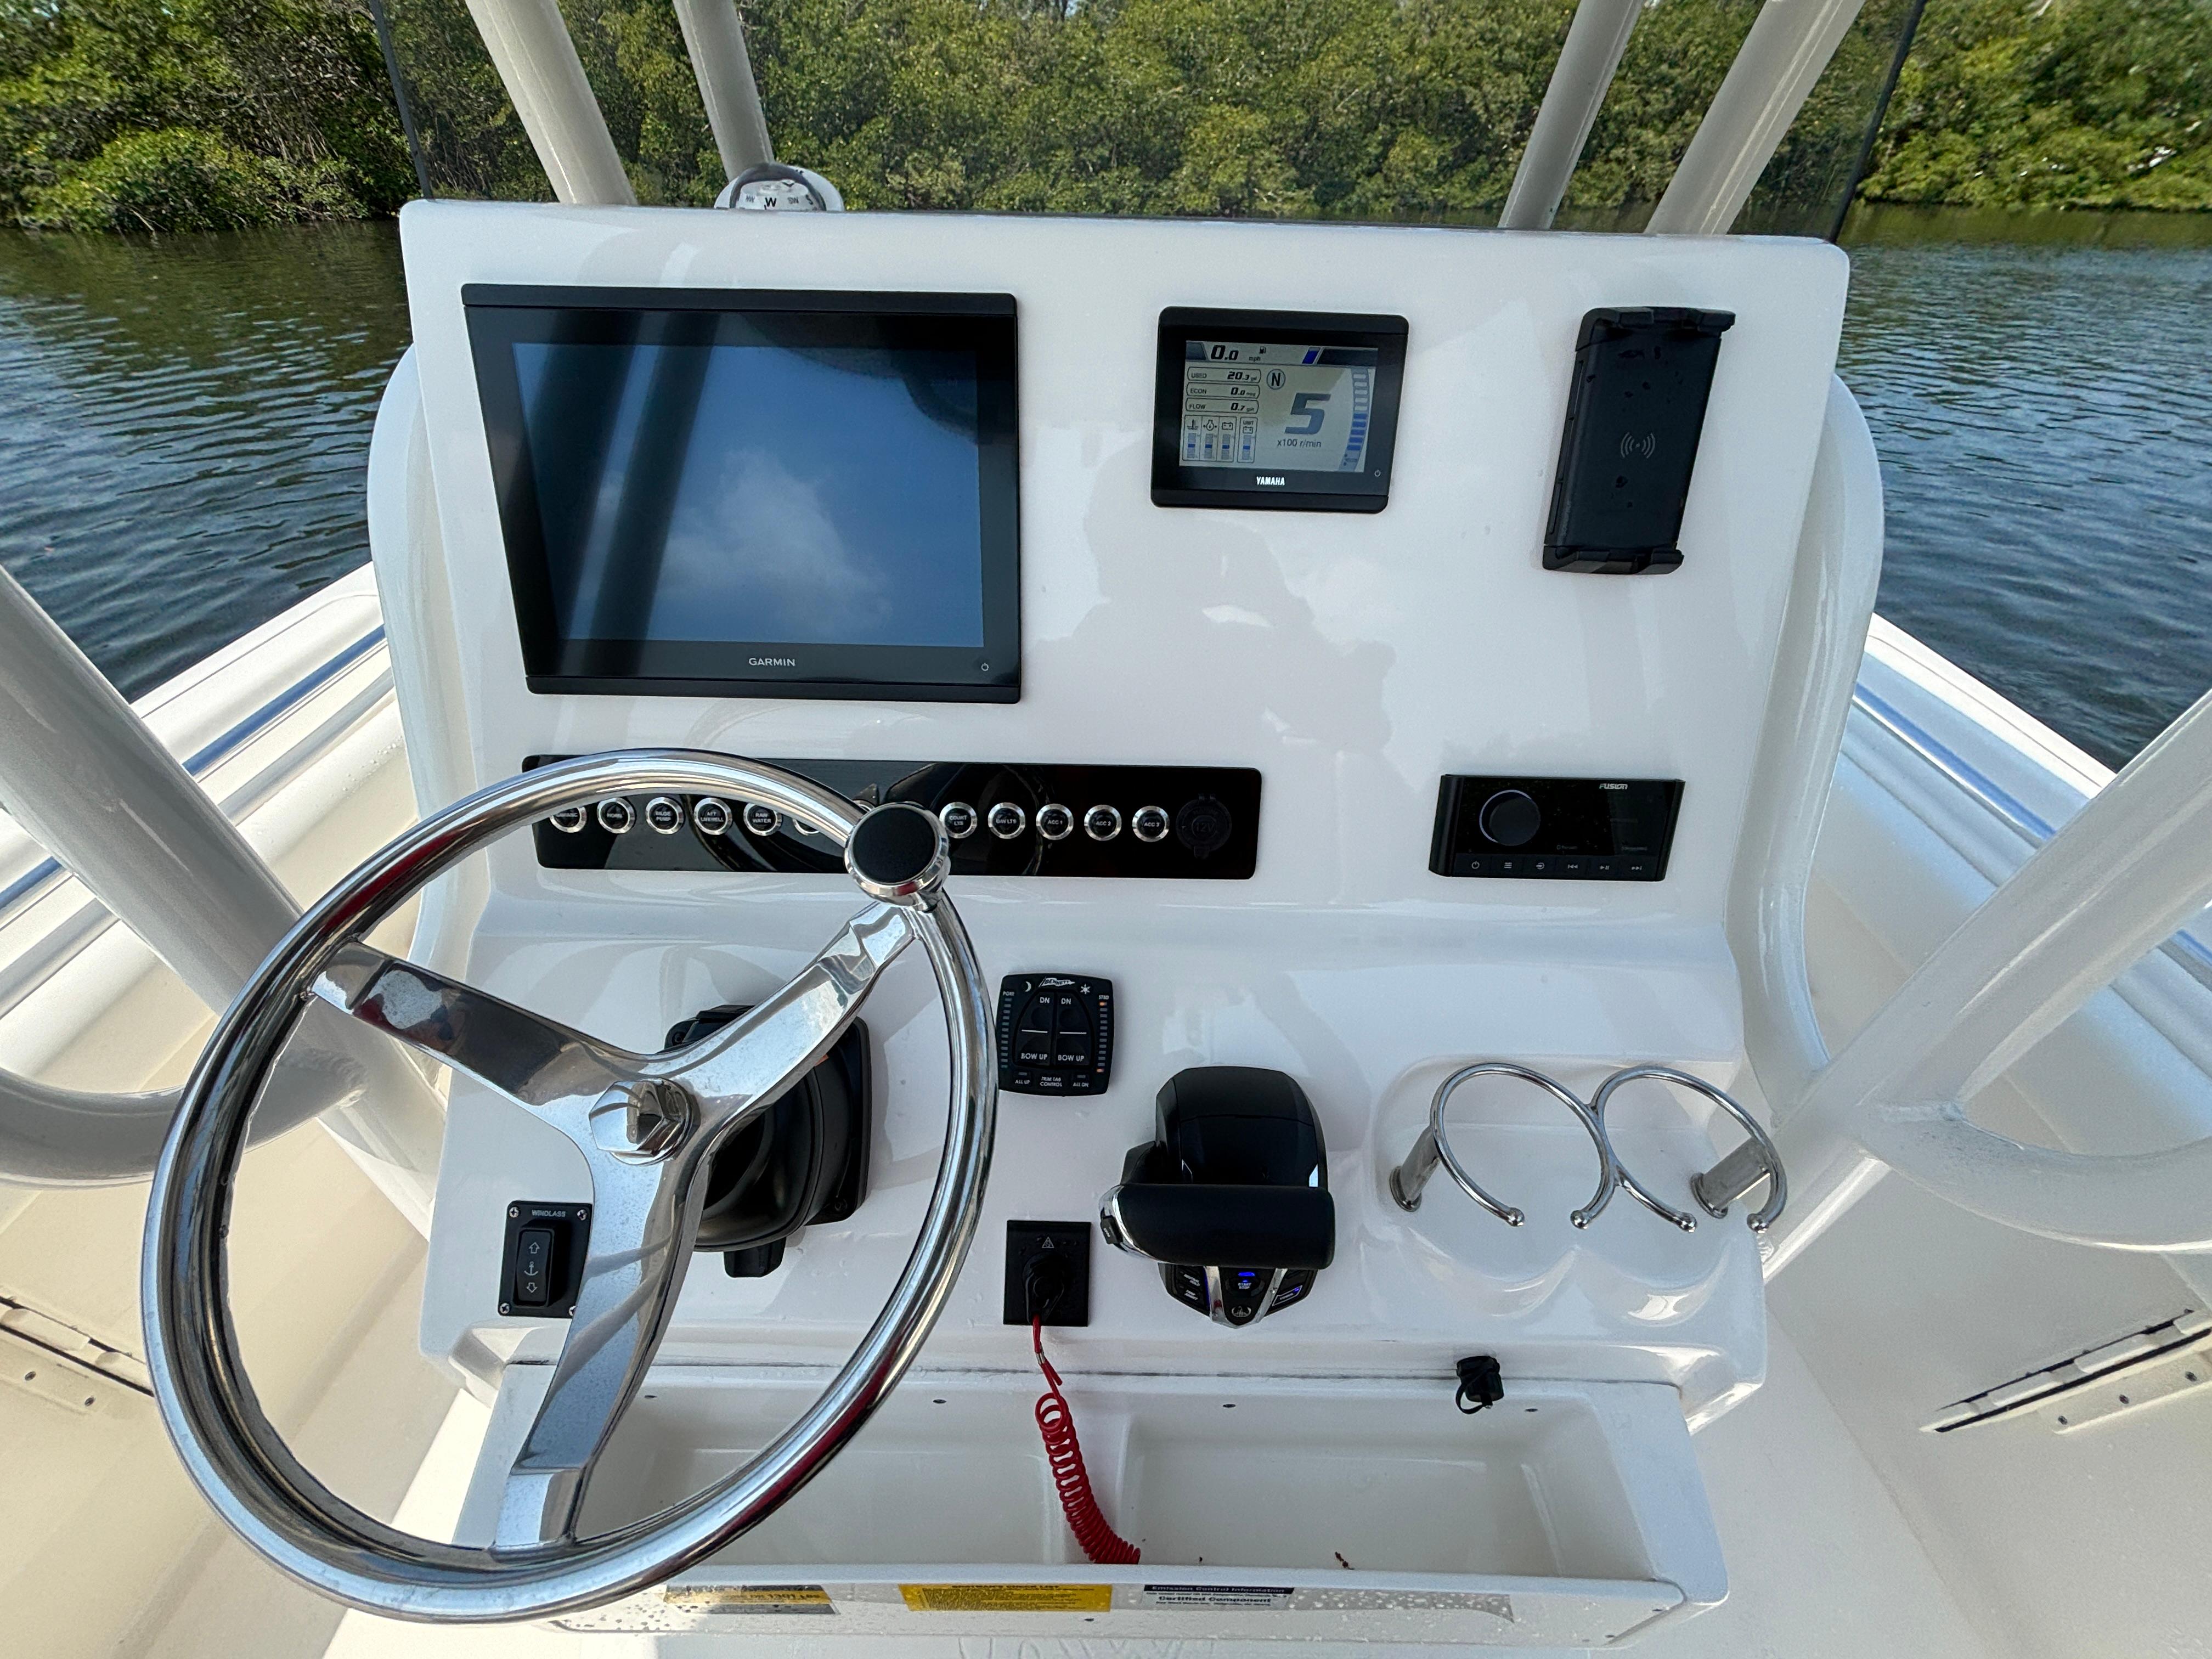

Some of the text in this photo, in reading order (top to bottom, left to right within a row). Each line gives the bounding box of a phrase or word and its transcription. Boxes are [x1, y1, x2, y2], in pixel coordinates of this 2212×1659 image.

[765, 198, 777, 207] W
[1211, 345, 1239, 362] 0.0
[1227, 371, 1250, 380] 20.3
[1271, 373, 1281, 387] N
[1231, 387, 1245, 396] 0.0
[1231, 403, 1245, 411] 0.7
[1285, 393, 1331, 435] 5
[1277, 439, 1322, 448] x100 r/min
[1256, 476, 1285, 486] YAMAHA
[749, 658, 795, 666] GARMIN
[1197, 823, 1215, 832] 12V
